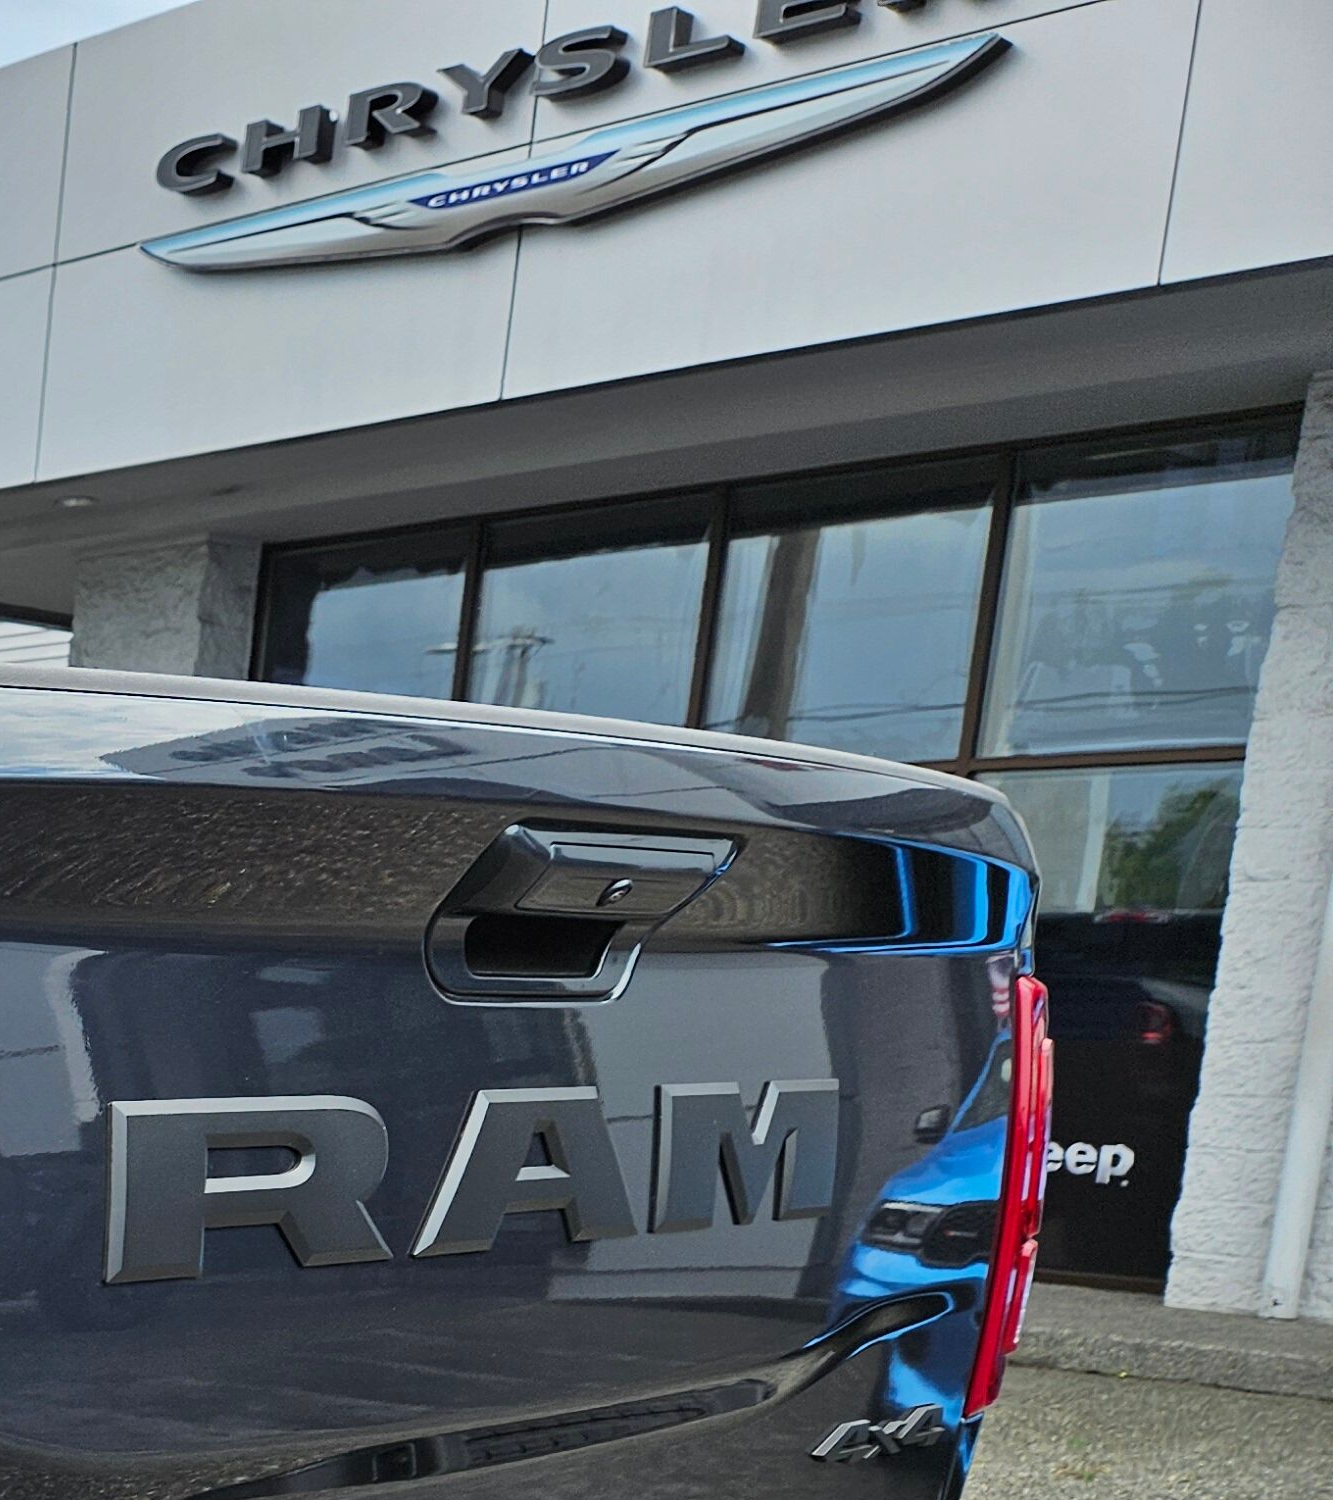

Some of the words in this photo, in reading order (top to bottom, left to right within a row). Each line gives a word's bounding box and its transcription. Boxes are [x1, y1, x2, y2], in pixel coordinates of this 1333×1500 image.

[156, 0, 927, 196] CHRYSLE
[427, 161, 590, 208] CHRYSLER
[102, 1078, 839, 1286] RAM
[1045, 1141, 1135, 1185] eep
